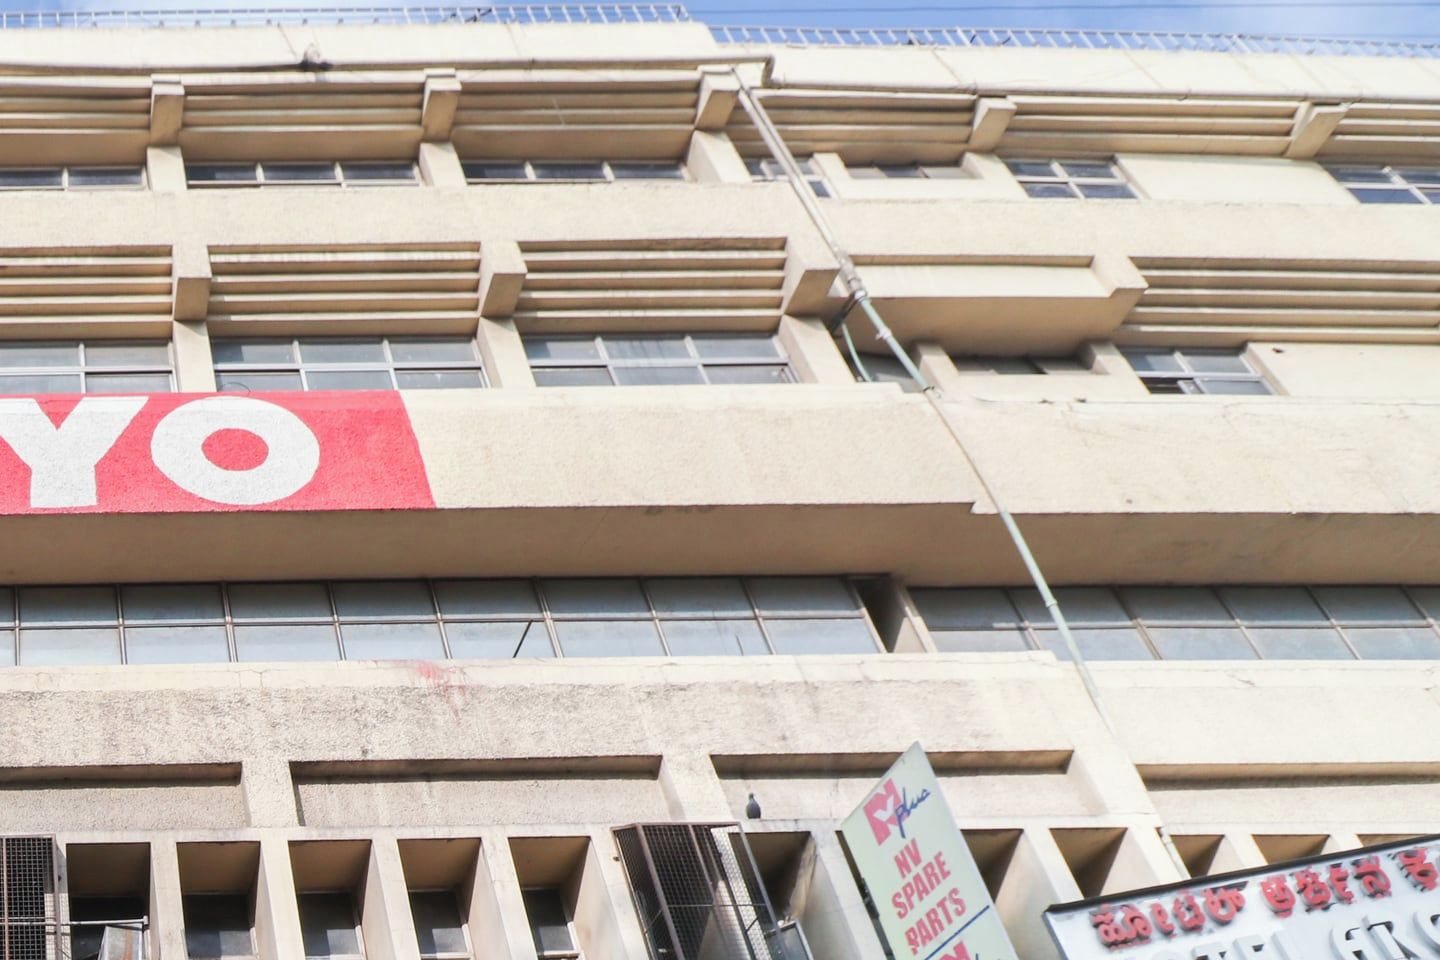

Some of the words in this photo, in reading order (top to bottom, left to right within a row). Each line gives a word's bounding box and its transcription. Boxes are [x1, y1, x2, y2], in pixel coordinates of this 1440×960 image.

[892, 851, 951, 920] SPARE
[894, 839, 922, 879] NV
[905, 887, 967, 956] PARTS
